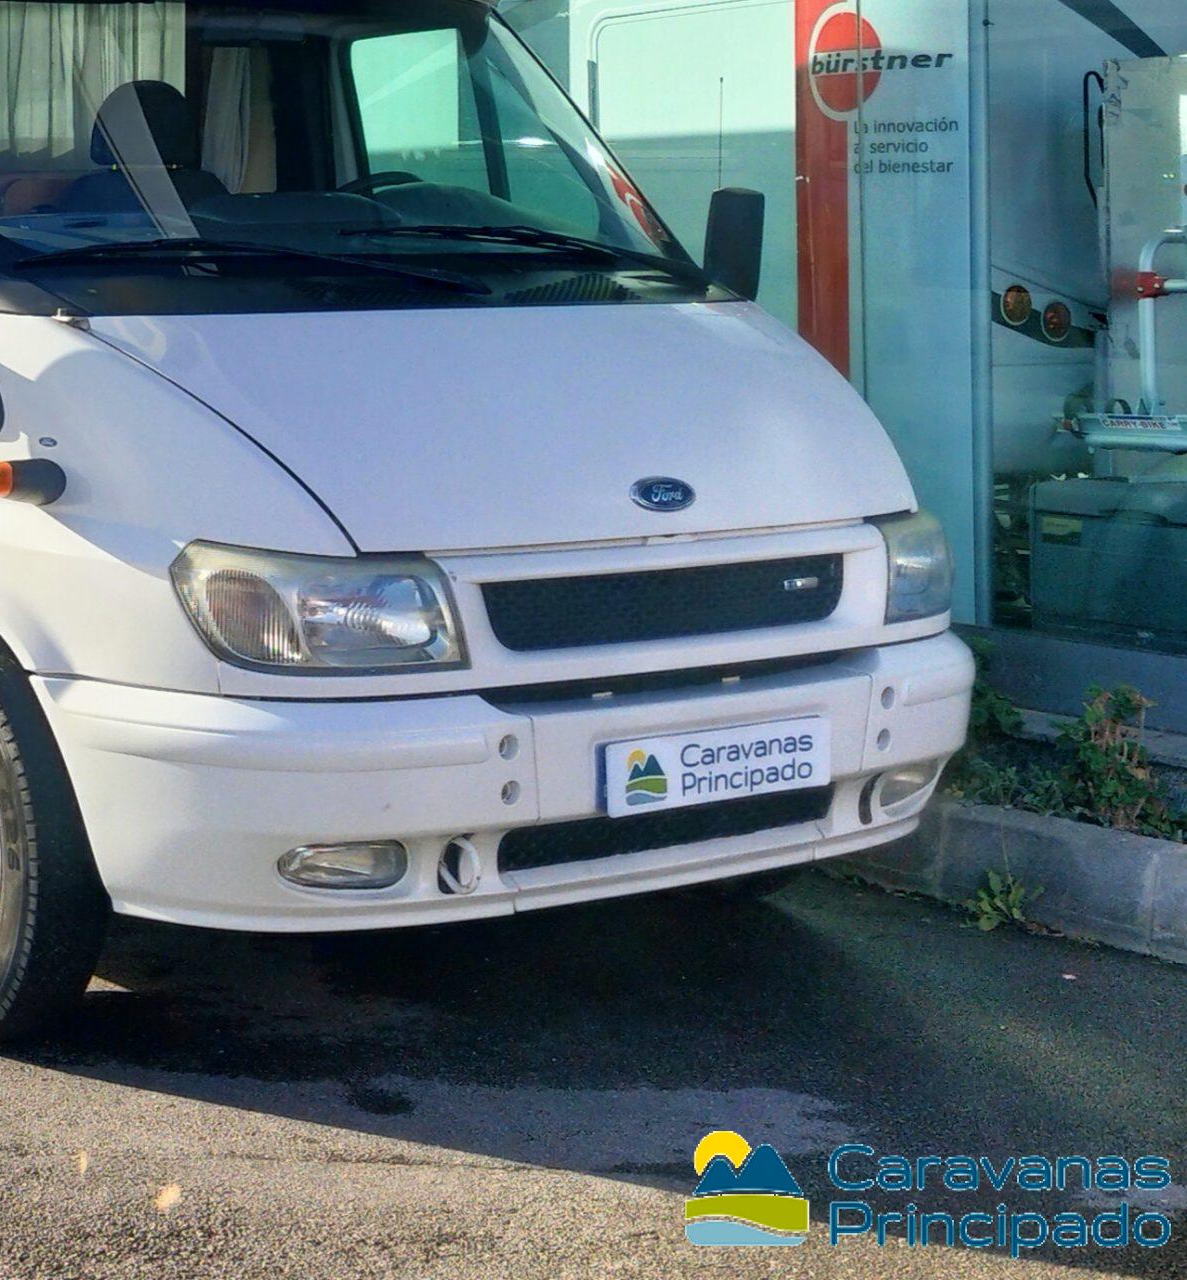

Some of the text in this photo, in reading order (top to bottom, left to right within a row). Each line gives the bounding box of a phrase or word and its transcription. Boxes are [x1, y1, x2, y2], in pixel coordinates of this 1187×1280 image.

[811, 49, 954, 76] bürstner
[873, 116, 959, 134] innovación
[869, 138, 929, 154] servicio
[878, 158, 955, 174] bienestar
[651, 483, 683, 503] Ford
[679, 733, 814, 768] Caravanas
[680, 757, 814, 797] Principado
